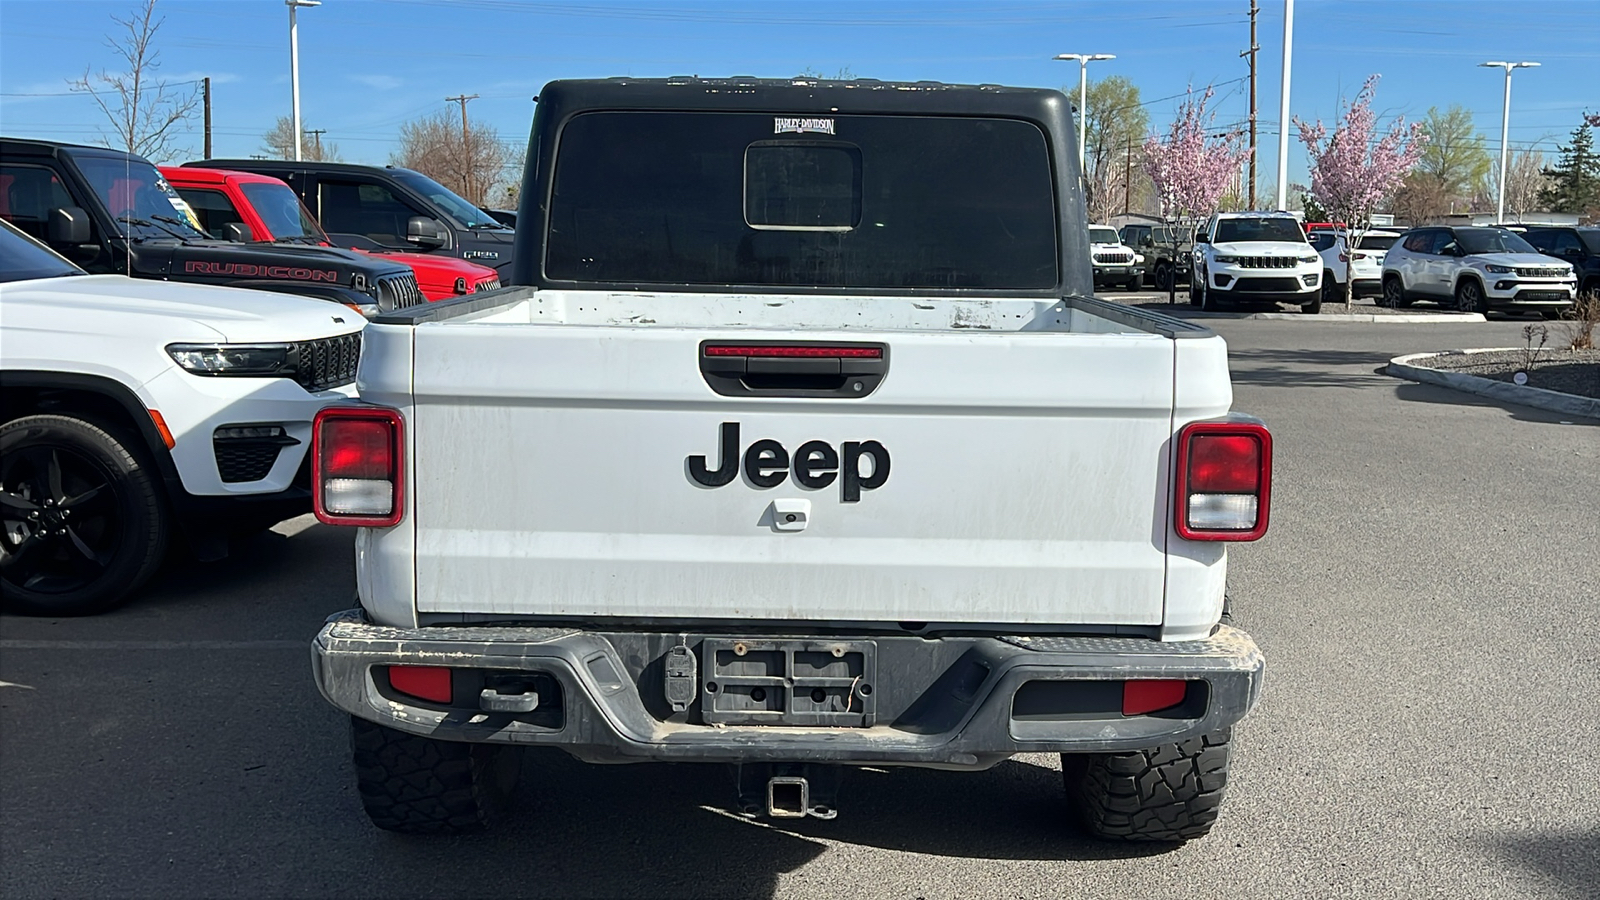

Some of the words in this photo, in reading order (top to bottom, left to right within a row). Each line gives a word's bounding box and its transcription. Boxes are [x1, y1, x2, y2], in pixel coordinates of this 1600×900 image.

[774, 117, 836, 135] HARLEY-DAVIDSON
[185, 261, 337, 282] RUBICON
[687, 421, 891, 503] Jeep
